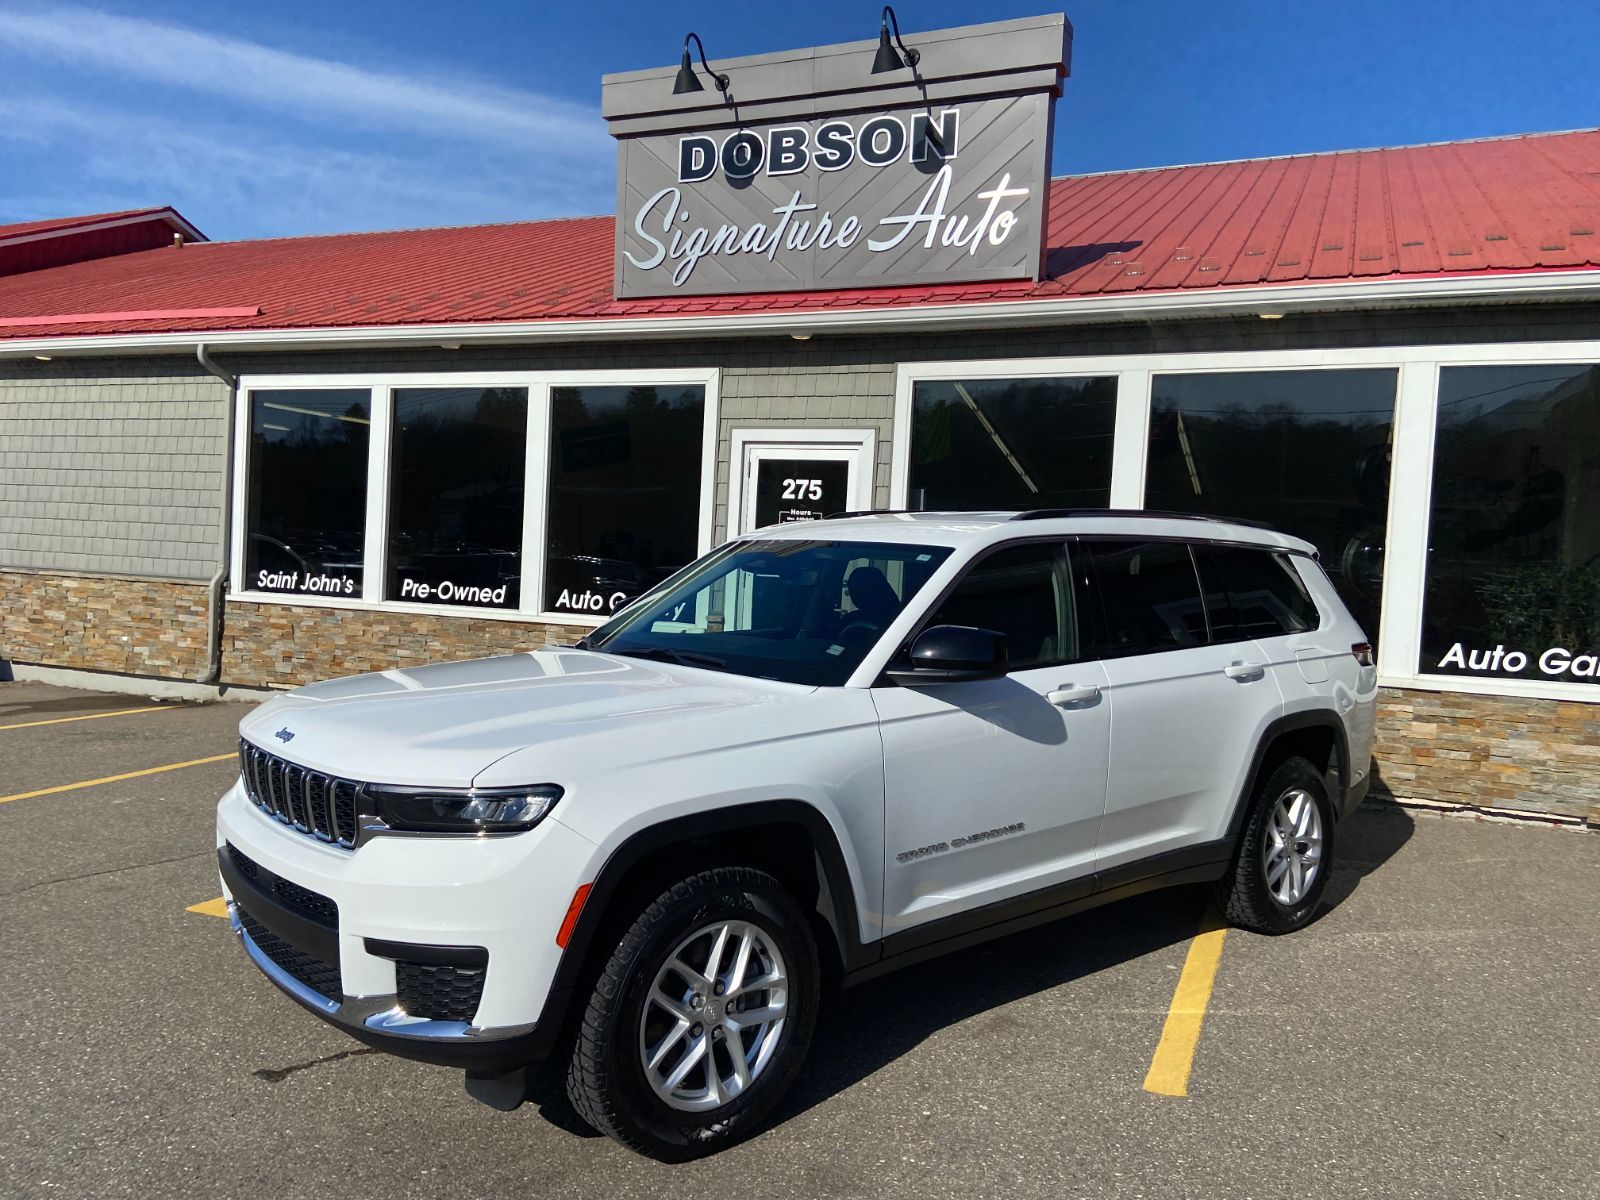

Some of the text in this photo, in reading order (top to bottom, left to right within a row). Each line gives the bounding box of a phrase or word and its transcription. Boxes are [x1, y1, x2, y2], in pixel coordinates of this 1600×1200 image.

[678, 108, 960, 184] DOBSON
[623, 164, 1030, 287] Signature Auto
[781, 478, 822, 500] 275
[790, 508, 812, 516] Hours
[257, 569, 354, 594] Saint John's
[401, 578, 507, 604] Pre-Owned
[555, 588, 604, 611] Auto
[1437, 642, 1600, 677] Auto Ga
